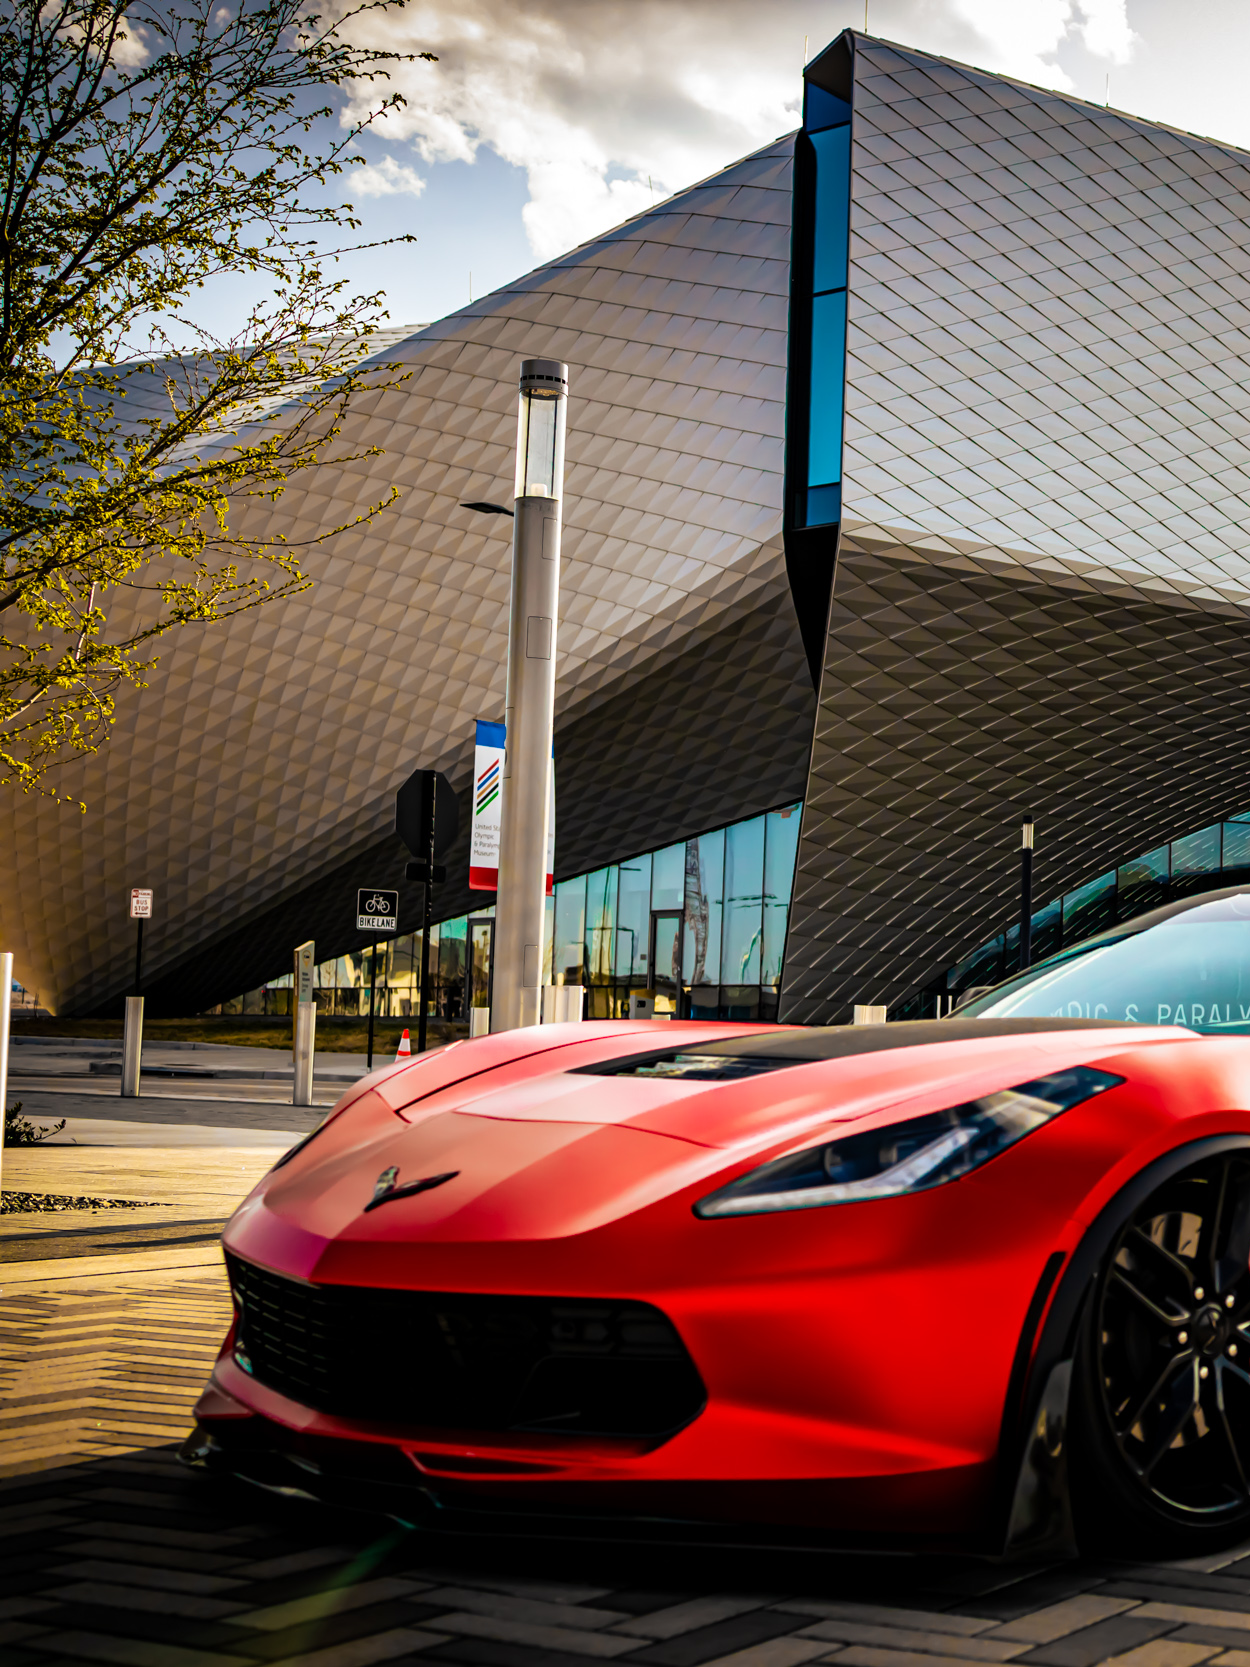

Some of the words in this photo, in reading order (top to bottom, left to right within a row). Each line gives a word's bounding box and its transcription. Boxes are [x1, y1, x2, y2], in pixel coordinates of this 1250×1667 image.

[475, 823, 492, 831] United
[474, 832, 494, 840] Olympic
[359, 916, 376, 927] BIKE
[377, 917, 395, 928] LANE
[1125, 1004, 1139, 1022] &
